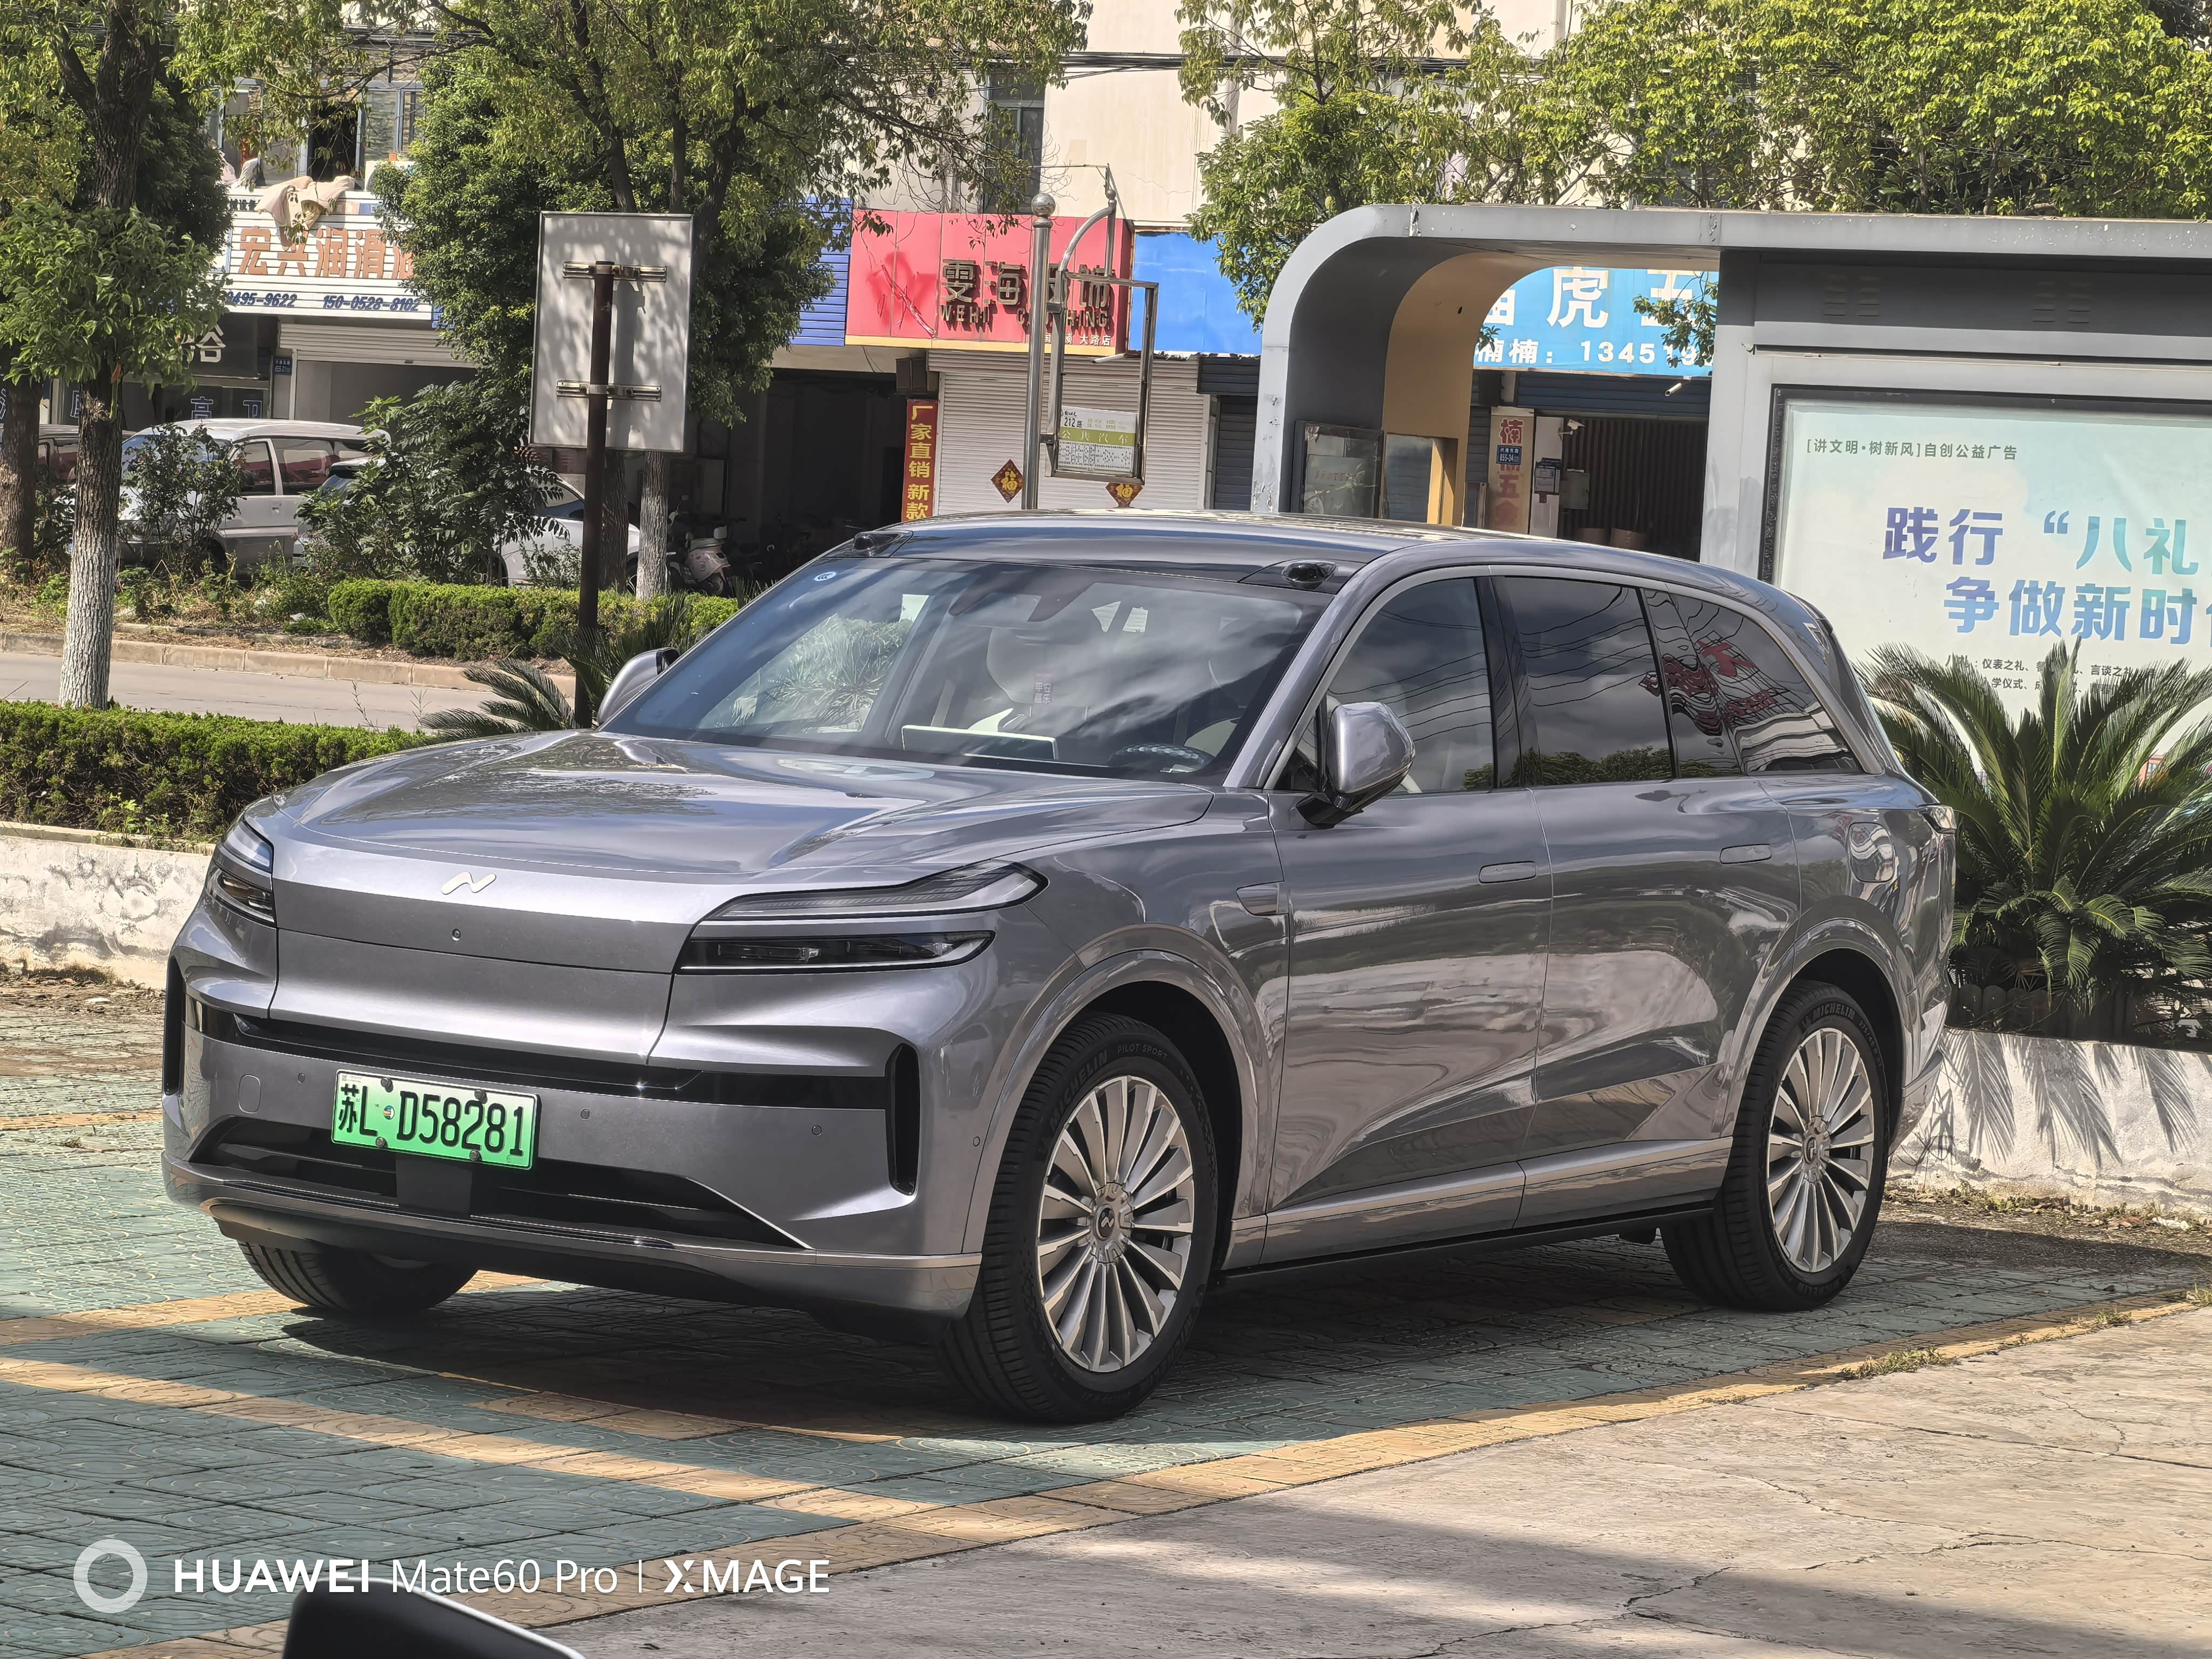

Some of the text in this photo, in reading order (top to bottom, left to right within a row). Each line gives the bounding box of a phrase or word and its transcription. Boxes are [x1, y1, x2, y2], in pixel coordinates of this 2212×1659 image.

[323, 295, 420, 312] 150-0528-8102
[940, 305, 1107, 328] WEHI CHING
[1080, 334, 1111, 346] 大路店
[1581, 340, 1714, 367] 134519
[906, 406, 933, 520] 厂家直销 新款
[1495, 419, 1524, 527] 楠五金
[1883, 507, 2003, 565] 践行
[1812, 1003, 1856, 1024] MICHELIN
[1117, 1043, 1168, 1060] PILOT SPORT
[1050, 1049, 1108, 1132] MICHELIN
[338, 1083, 524, 1157] 苏L D58281
